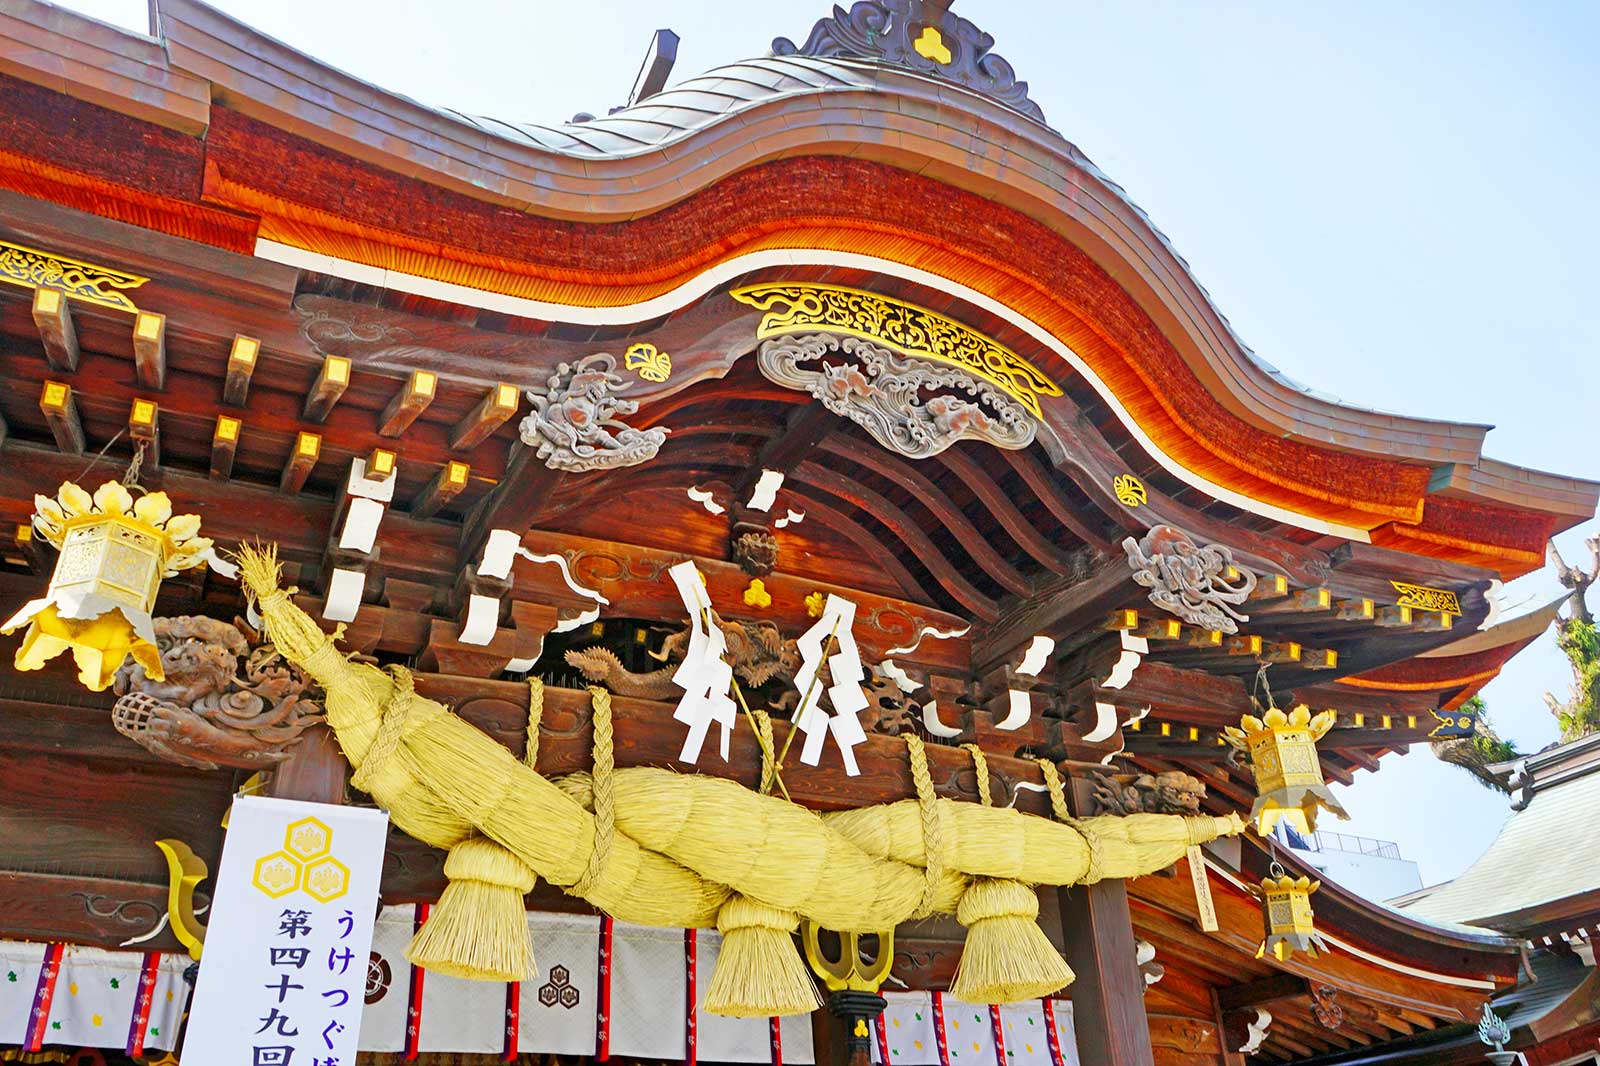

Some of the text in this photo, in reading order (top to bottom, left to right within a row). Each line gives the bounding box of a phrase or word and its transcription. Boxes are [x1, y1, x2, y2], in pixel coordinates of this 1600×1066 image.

[253, 908, 313, 1066] 第四十九回
